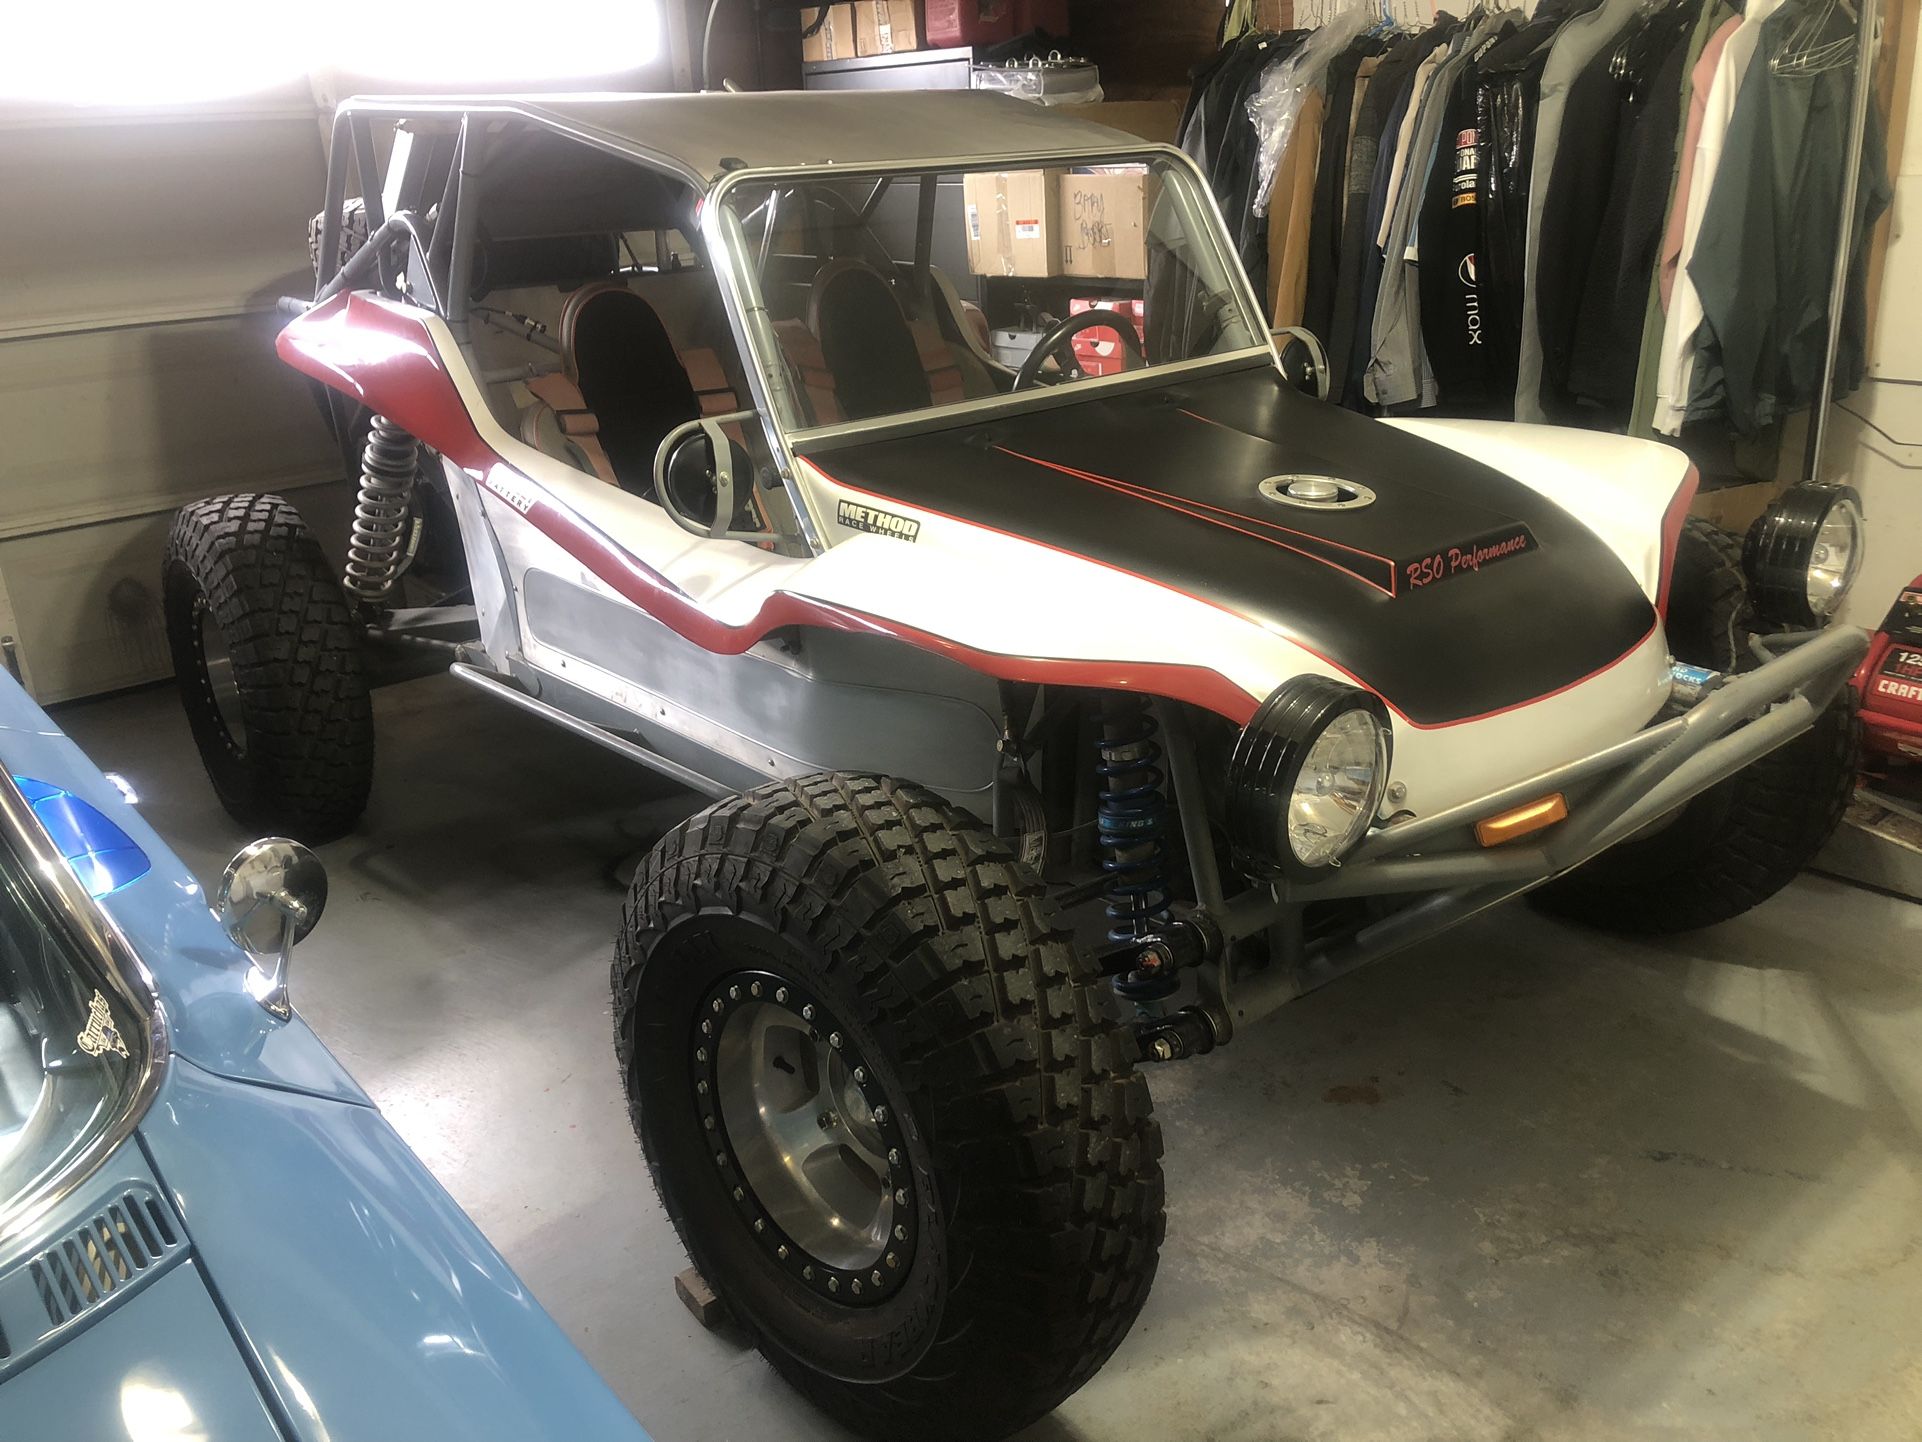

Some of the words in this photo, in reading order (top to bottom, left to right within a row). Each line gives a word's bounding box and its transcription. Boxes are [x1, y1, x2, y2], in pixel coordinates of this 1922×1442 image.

[838, 516, 865, 530] RACE
[839, 501, 919, 537] METHOD
[1406, 554, 1444, 590] RSO
[1448, 534, 1527, 574] Performance
